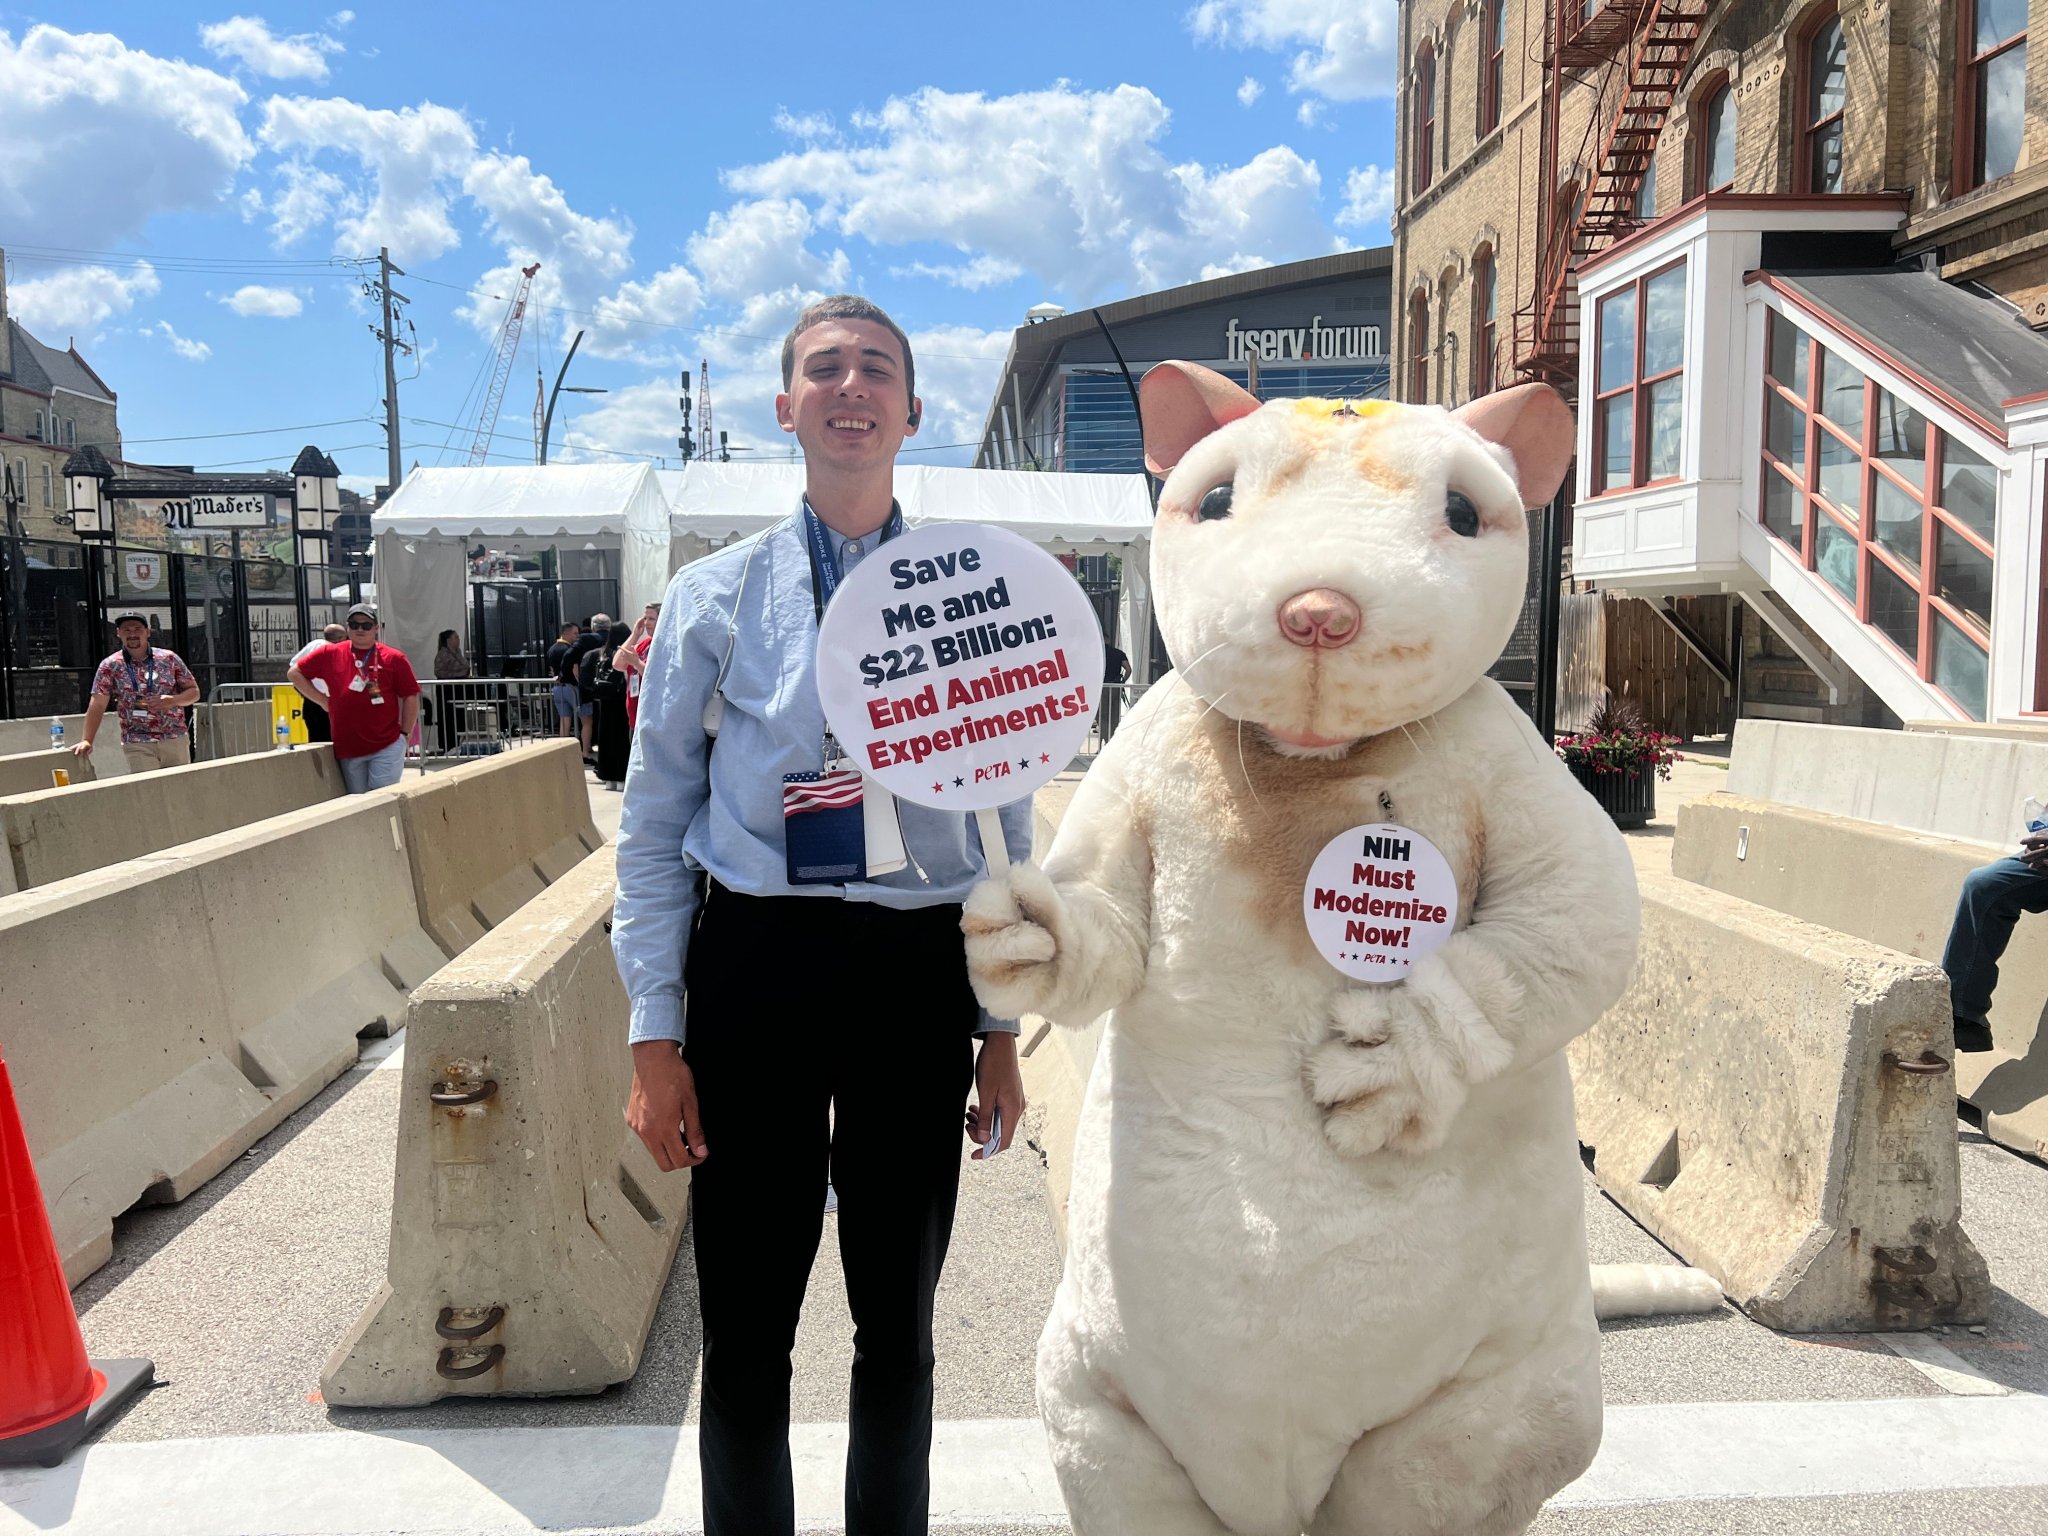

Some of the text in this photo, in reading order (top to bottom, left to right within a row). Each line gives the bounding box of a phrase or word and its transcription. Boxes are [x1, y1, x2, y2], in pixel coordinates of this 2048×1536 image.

[193, 497, 263, 515] Mader's
[812, 518, 827, 558] FREESPOKE
[890, 548, 981, 590] Save
[882, 577, 1010, 638] Me and
[859, 614, 1057, 689] $22 Billion:
[867, 649, 1070, 730] End Animal
[866, 685, 1090, 770] Experiments!
[1362, 835, 1411, 862] NIH
[1352, 862, 1416, 891] Must
[1313, 888, 1447, 924] Modernize
[1344, 920, 1411, 948] Now!
